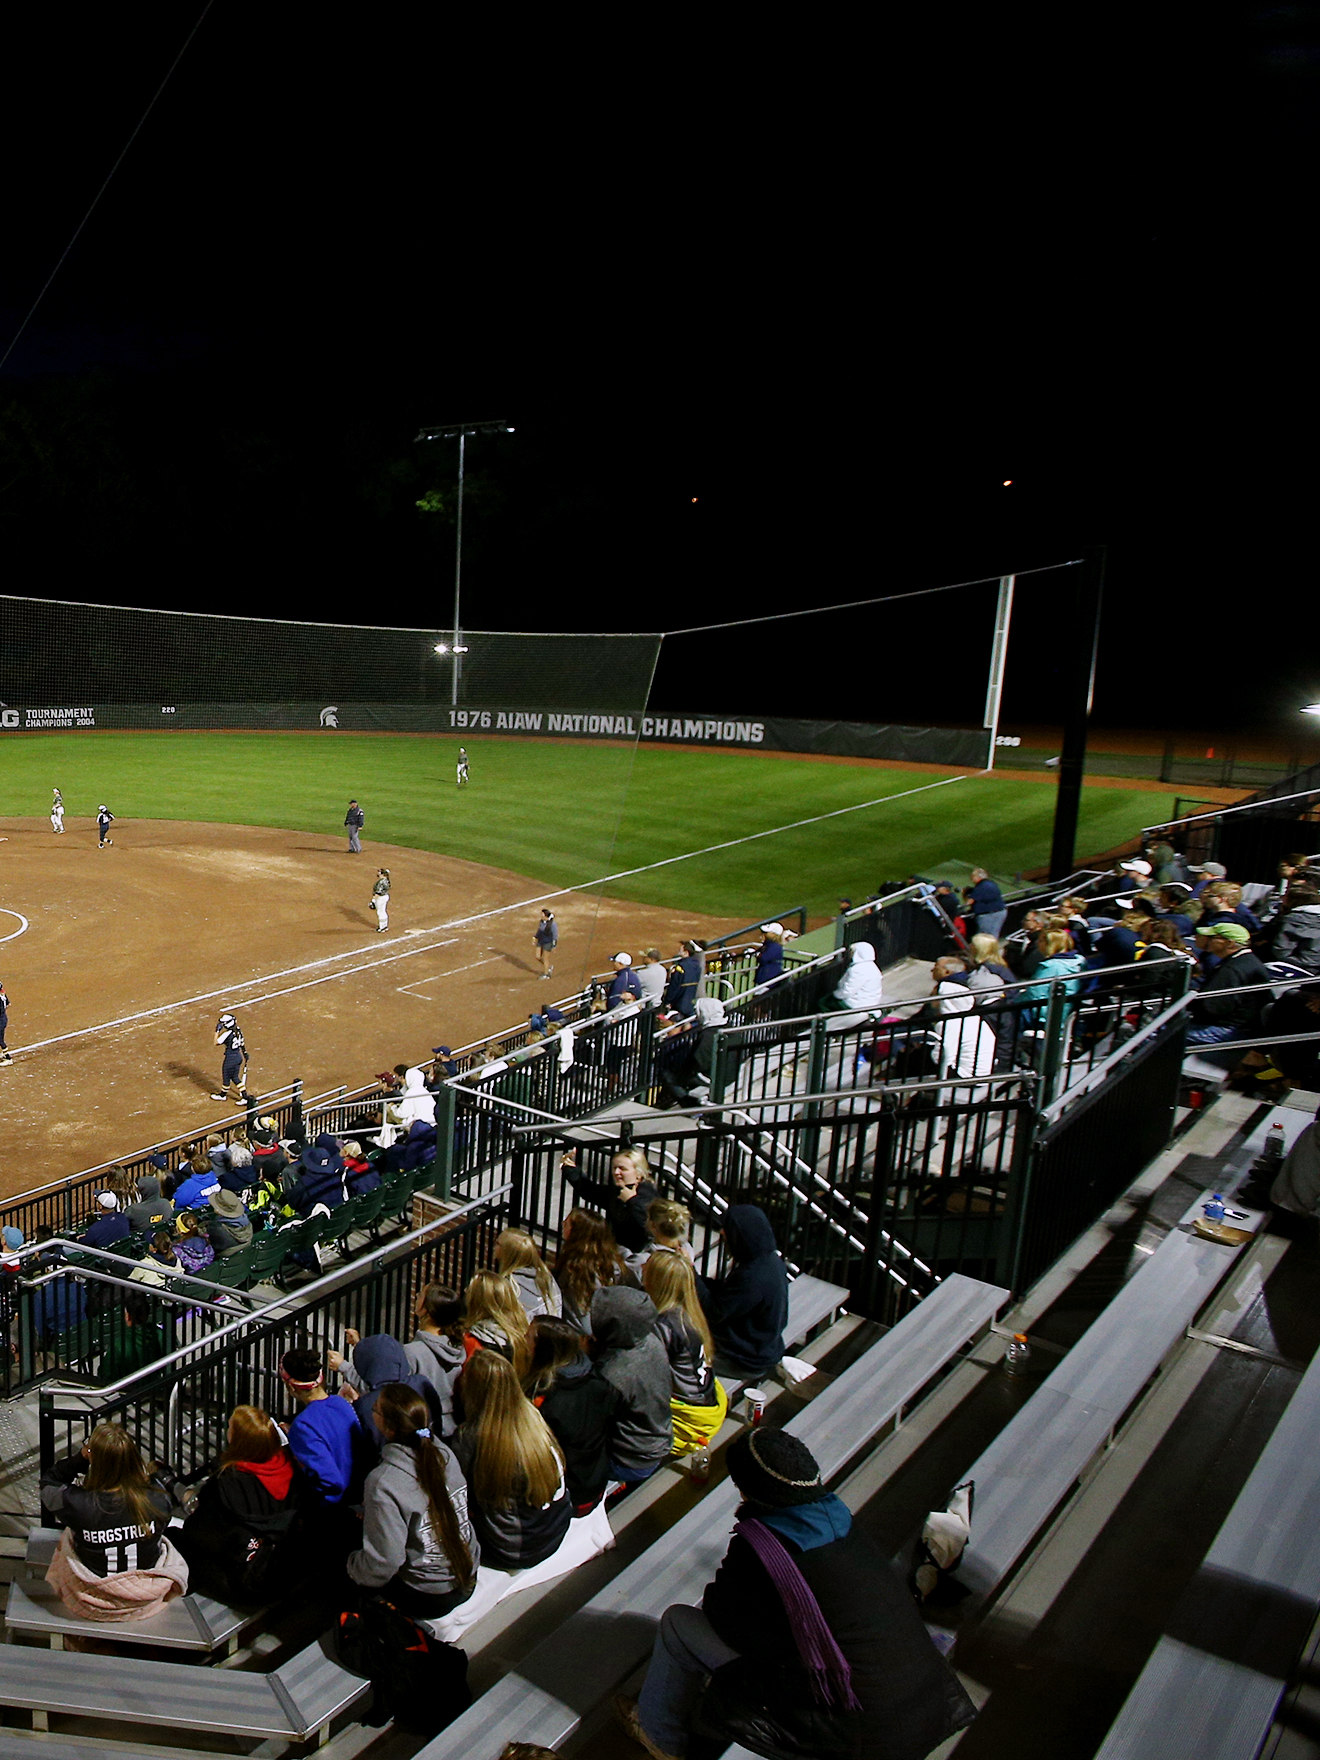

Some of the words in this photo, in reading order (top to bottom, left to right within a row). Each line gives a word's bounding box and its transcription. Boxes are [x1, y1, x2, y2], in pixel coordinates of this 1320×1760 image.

[26, 708, 94, 719] TOURNAMENT
[161, 706, 176, 714] 220
[25, 718, 73, 728] CHAMPIONS
[76, 717, 95, 726] 2004
[448, 710, 491, 728] 1976
[496, 711, 543, 730] AIAW
[548, 713, 637, 735] NATIONAL
[642, 717, 765, 743] CHAMPIONS
[105, 1543, 137, 1577] 11
